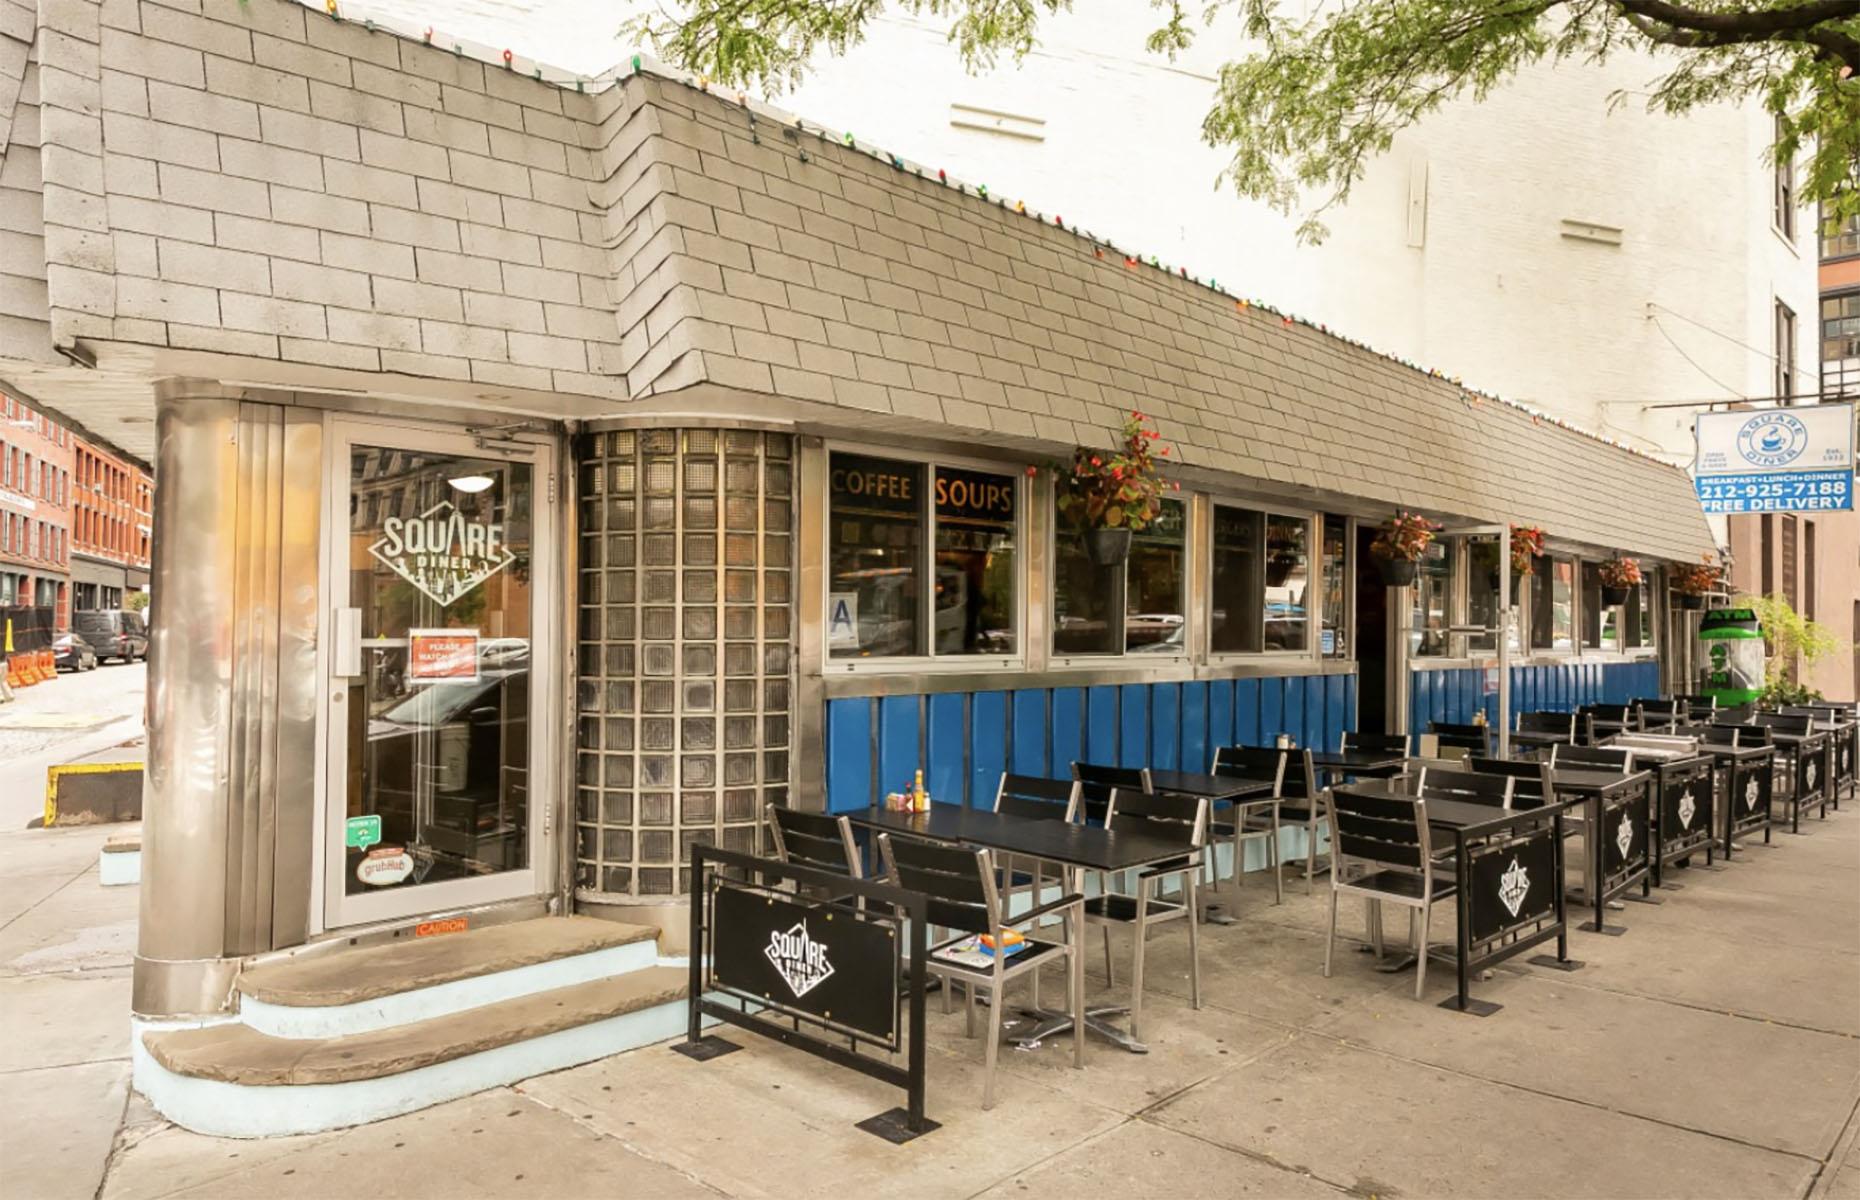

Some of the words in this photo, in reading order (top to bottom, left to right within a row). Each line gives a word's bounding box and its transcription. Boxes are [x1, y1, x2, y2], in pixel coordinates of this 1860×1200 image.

[1742, 414, 1804, 438] SQUARE
[1746, 449, 1798, 465] DINER
[832, 470, 911, 500] COFFEE
[936, 478, 1012, 512] SOUPS
[1701, 481, 1846, 498] 212-925-7188
[1702, 500, 1744, 512] FREE
[1751, 497, 1846, 510] DELIVERY
[384, 512, 503, 562] SQUARE
[417, 555, 470, 569] DINER
[831, 600, 851, 632] A
[1708, 611, 1751, 619] ATM
[771, 928, 828, 974] SQUARE
